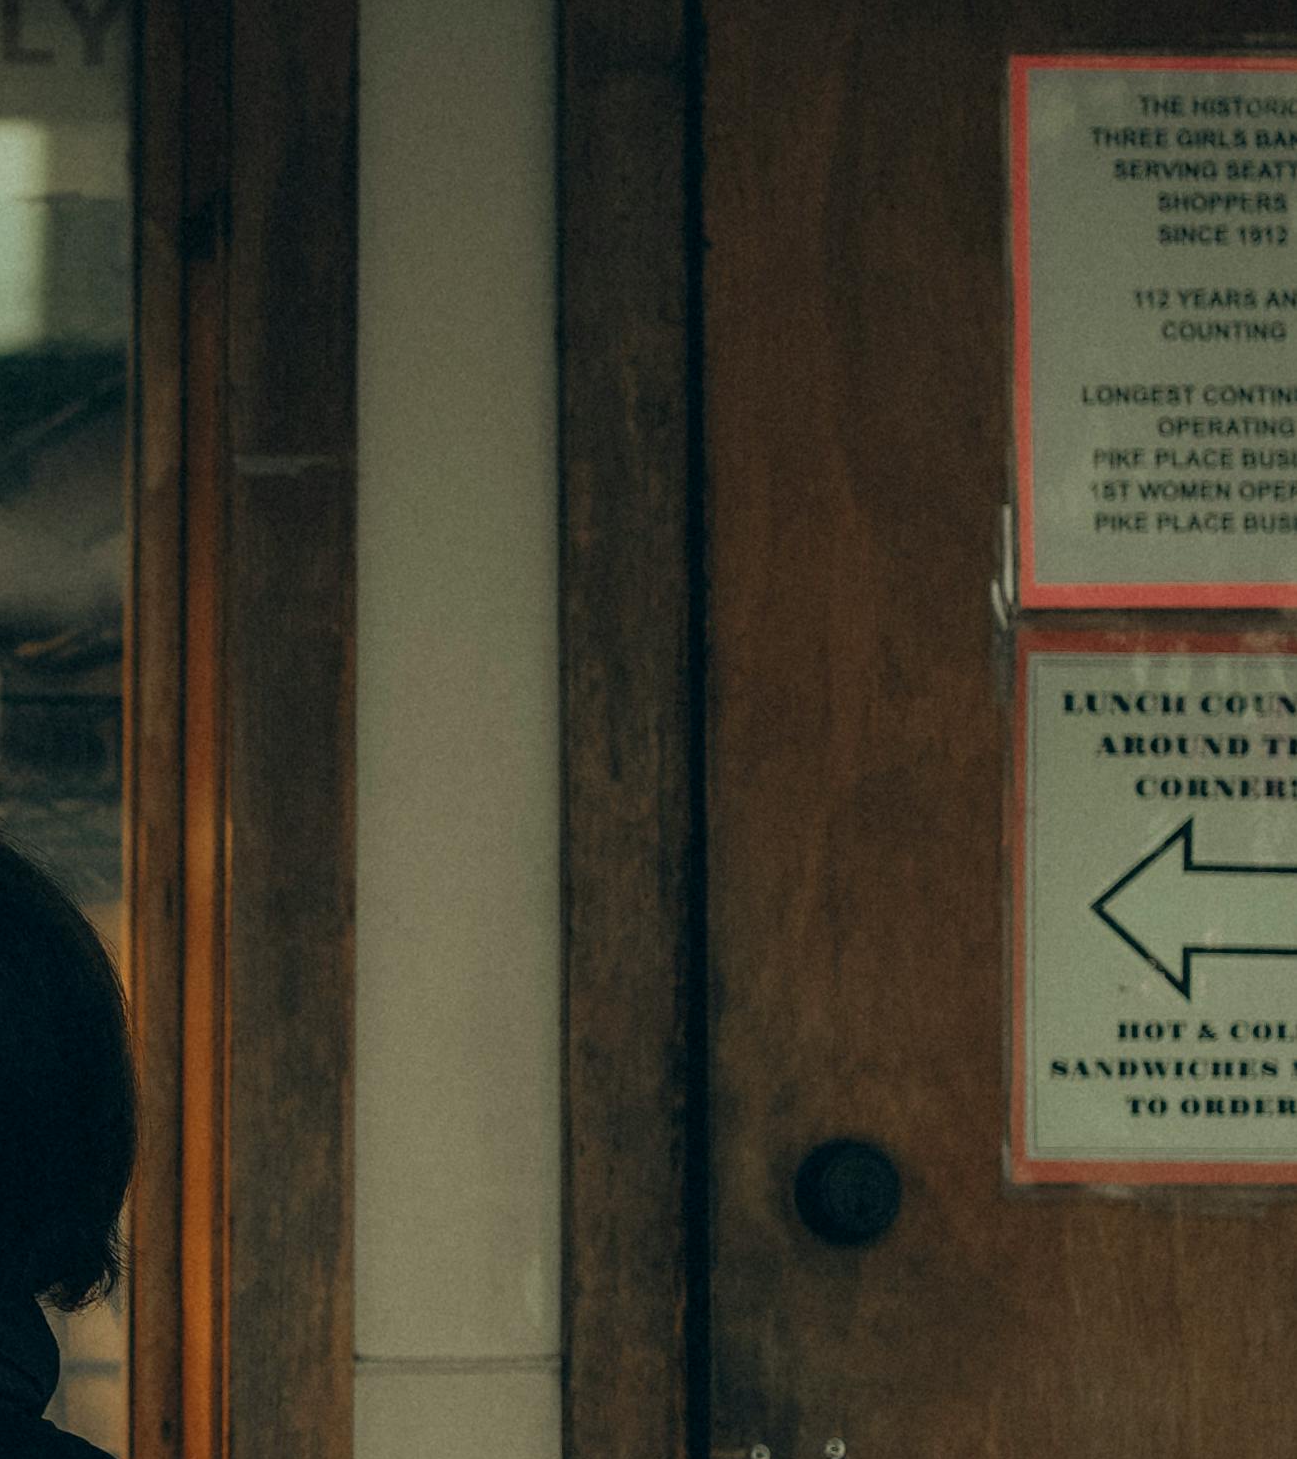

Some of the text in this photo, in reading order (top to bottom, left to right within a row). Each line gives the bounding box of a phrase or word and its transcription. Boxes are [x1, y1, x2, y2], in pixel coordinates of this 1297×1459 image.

[1140, 95, 1182, 117] THE
[1092, 126, 1167, 148] THREE
[1177, 127, 1247, 148] GIRLS
[1114, 158, 1217, 180] SERVING
[1159, 192, 1287, 213] SHOPPERS
[1160, 224, 1288, 245] SINCE 1912
[1135, 289, 1169, 308] 112
[1179, 289, 1256, 308] YEARS
[1162, 320, 1287, 342] COUNTING
[1082, 385, 1194, 406] LONGEST
[1158, 417, 1295, 437] OPERATING
[1093, 448, 1145, 469] PIKE
[1155, 448, 1233, 469] PLACE
[1091, 480, 1129, 501] 1ST
[1138, 480, 1231, 501] WOMEN
[1095, 512, 1147, 533] PIKE
[1158, 512, 1233, 533] PLACE
[1063, 693, 1185, 715] LUNCH
[1097, 735, 1249, 756] AROUND
[1118, 1021, 1186, 1040] HOT
[1198, 1023, 1217, 1039] &
[1051, 1058, 1279, 1078] SANDWICHES
[1126, 1096, 1297, 1117] TO ORDER
